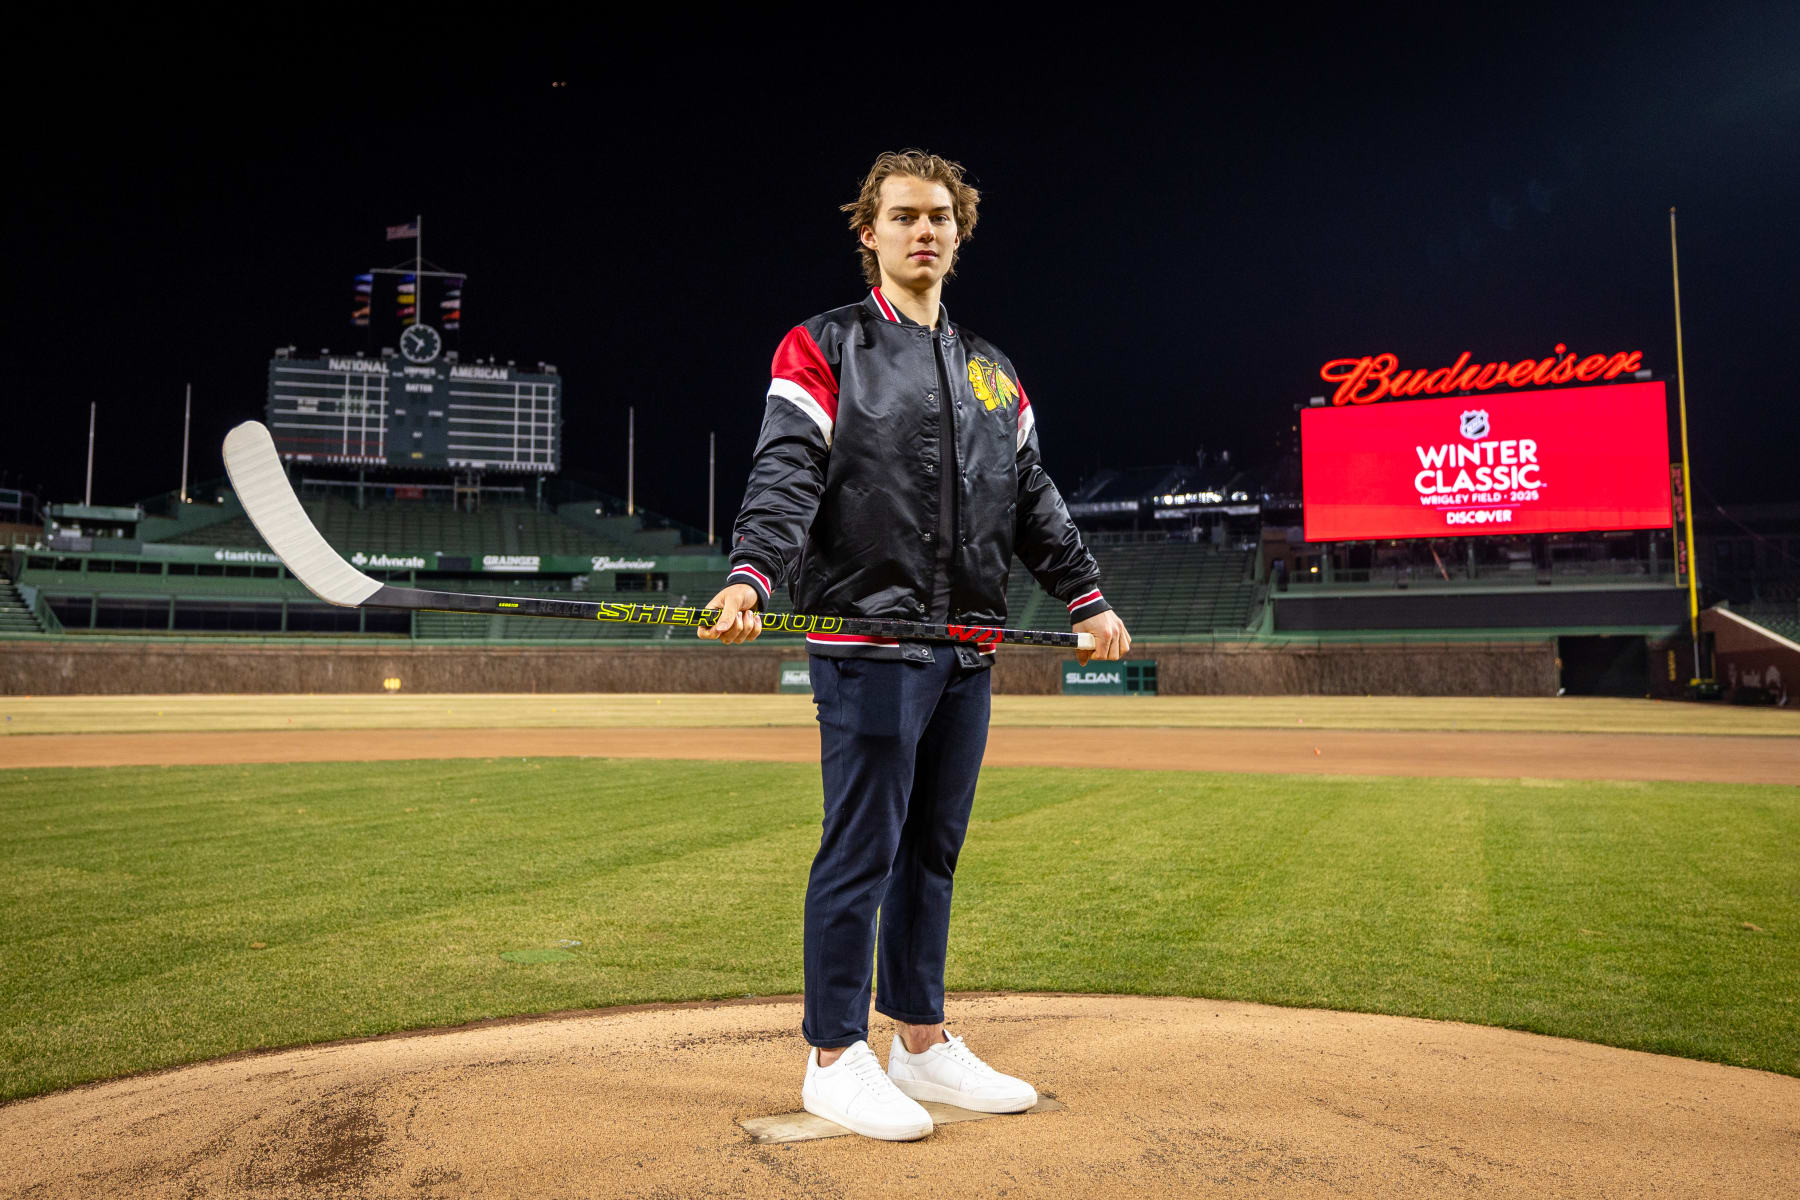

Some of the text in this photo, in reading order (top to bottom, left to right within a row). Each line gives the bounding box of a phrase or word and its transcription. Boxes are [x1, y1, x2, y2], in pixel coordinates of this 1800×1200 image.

[328, 358, 389, 374] NATIONAL
[450, 366, 509, 380] AMERICAN
[1320, 342, 1643, 407] Budweiser
[1416, 439, 1538, 469] WINTER
[1414, 464, 1541, 494] CLASSIC
[1420, 490, 1540, 505] WRIGLEY FIELD 2025
[1446, 509, 1513, 525] DISCOVER
[224, 549, 281, 562] tastytra
[368, 554, 425, 568] Advocate
[482, 555, 541, 566] GRAINGER
[591, 556, 656, 571] Budweiser
[597, 601, 843, 634] SHEROOD
[1065, 672, 1119, 684] SLOAN
